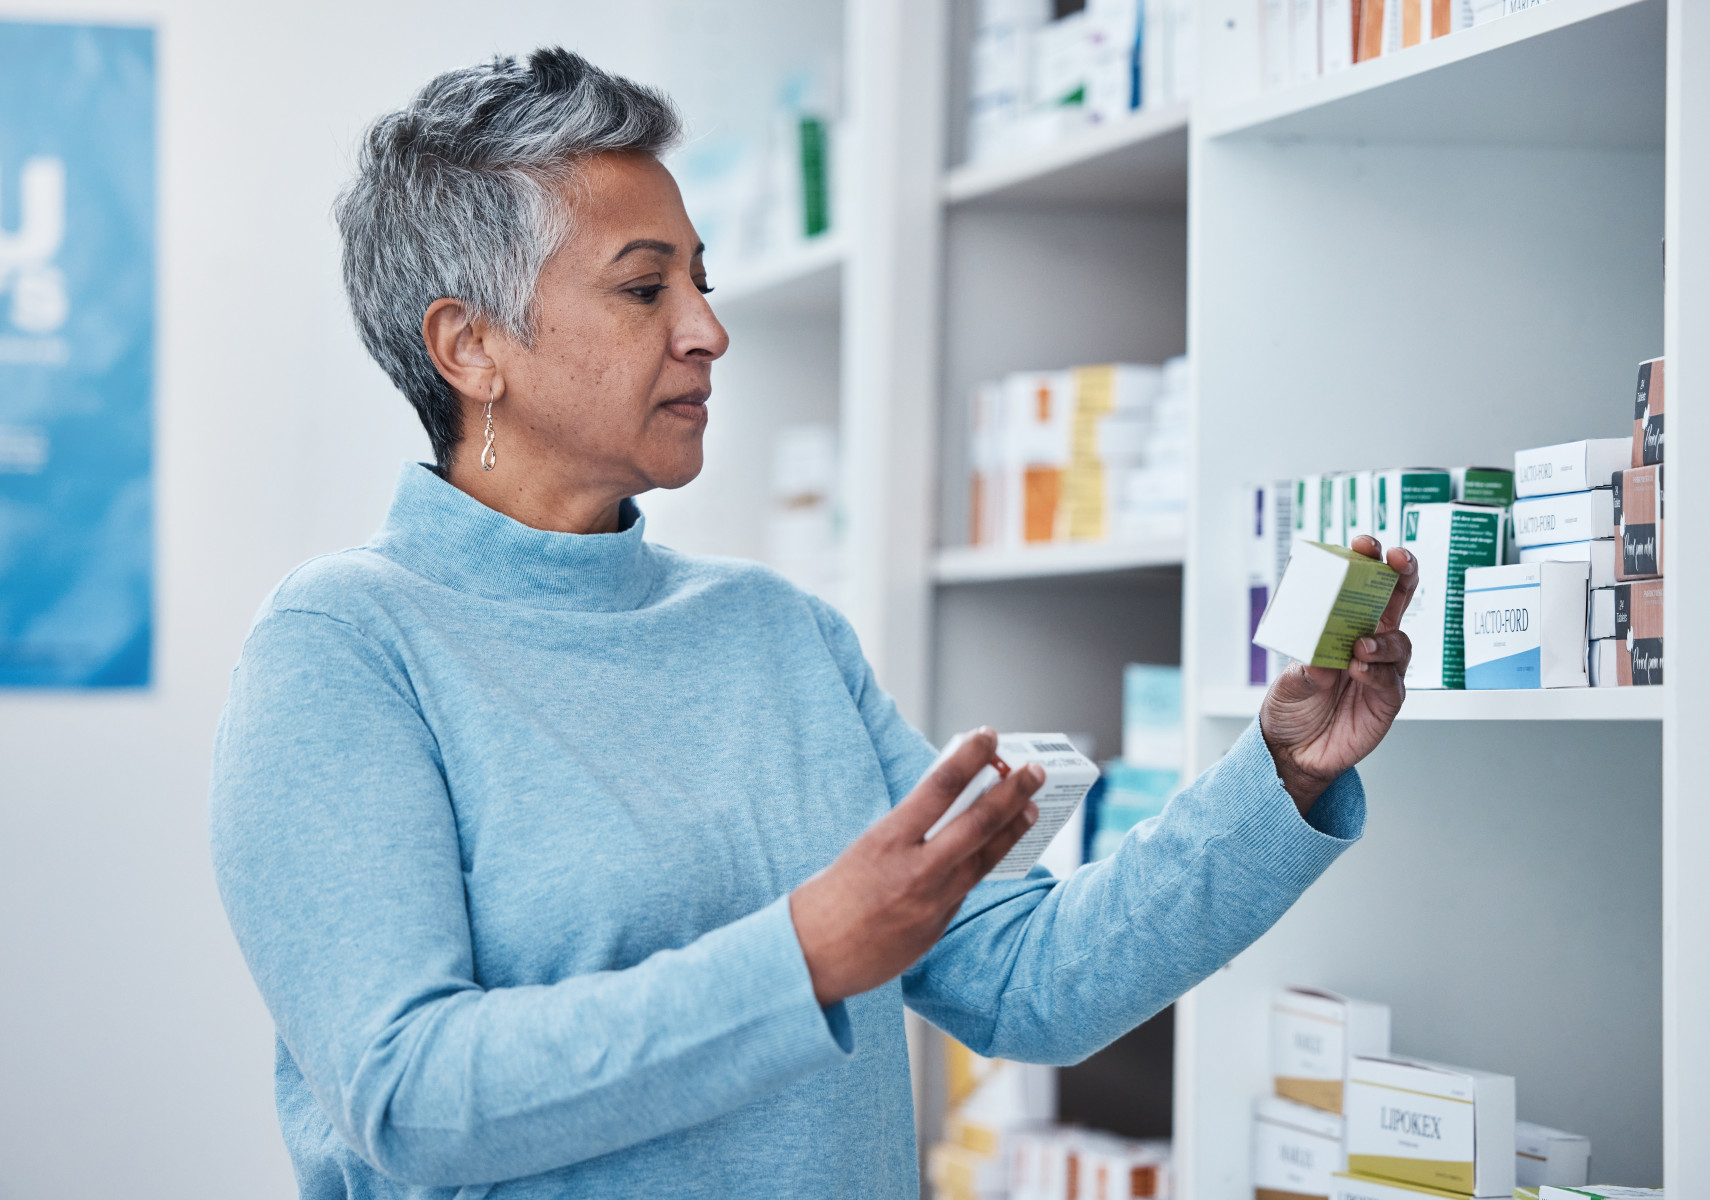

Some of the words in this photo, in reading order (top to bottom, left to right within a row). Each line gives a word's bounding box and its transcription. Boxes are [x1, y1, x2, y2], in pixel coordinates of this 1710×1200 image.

[1520, 462, 1552, 483] LACTO-FORD
[1519, 514, 1556, 534] LACTO-FORD
[1474, 608, 1529, 635] LACTO-FORD
[1380, 1106, 1442, 1140] LIPOKEX
